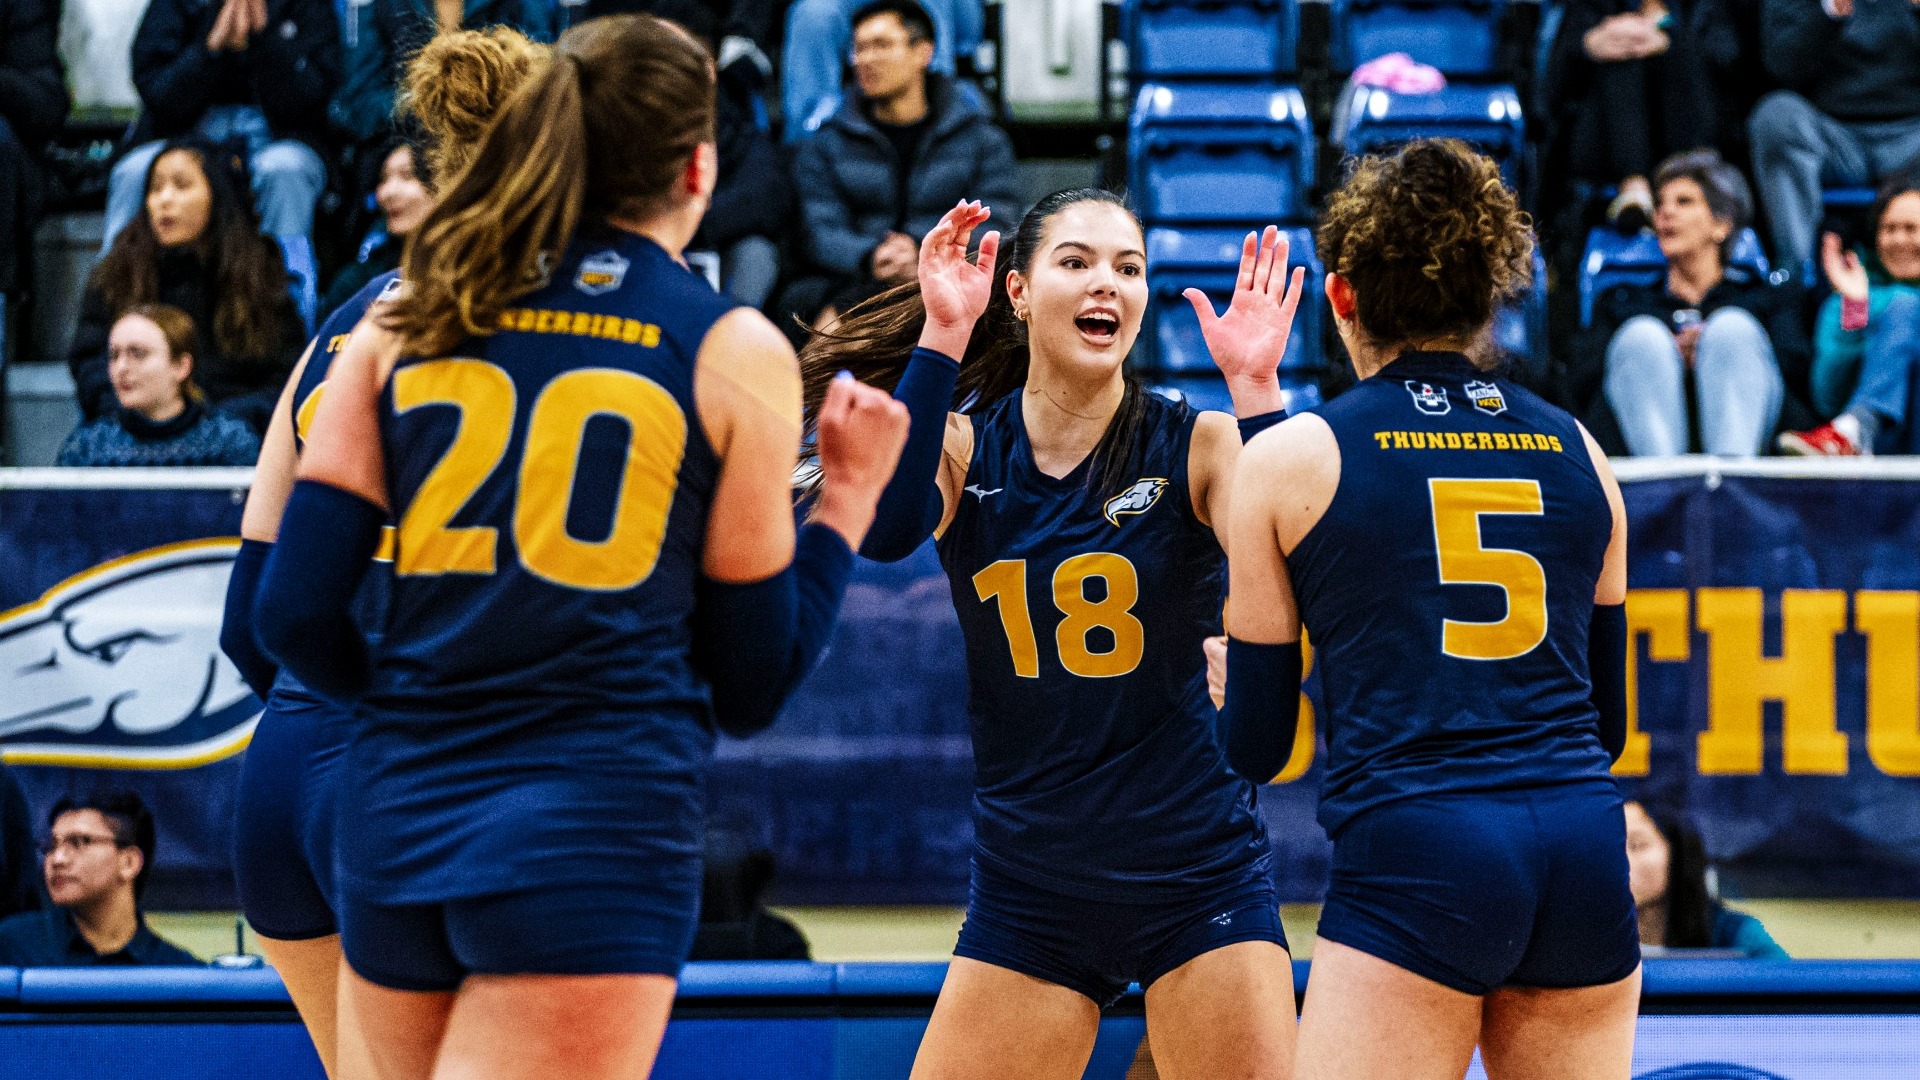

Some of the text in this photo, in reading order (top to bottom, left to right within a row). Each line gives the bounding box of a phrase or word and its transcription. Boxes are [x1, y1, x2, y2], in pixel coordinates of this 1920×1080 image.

[499, 308, 662, 348] NDERBIRDS
[392, 357, 689, 592] 20
[1374, 431, 1563, 453] THUNDERBIRDS
[972, 552, 1144, 678] 18
[1427, 477, 1549, 661] 5
